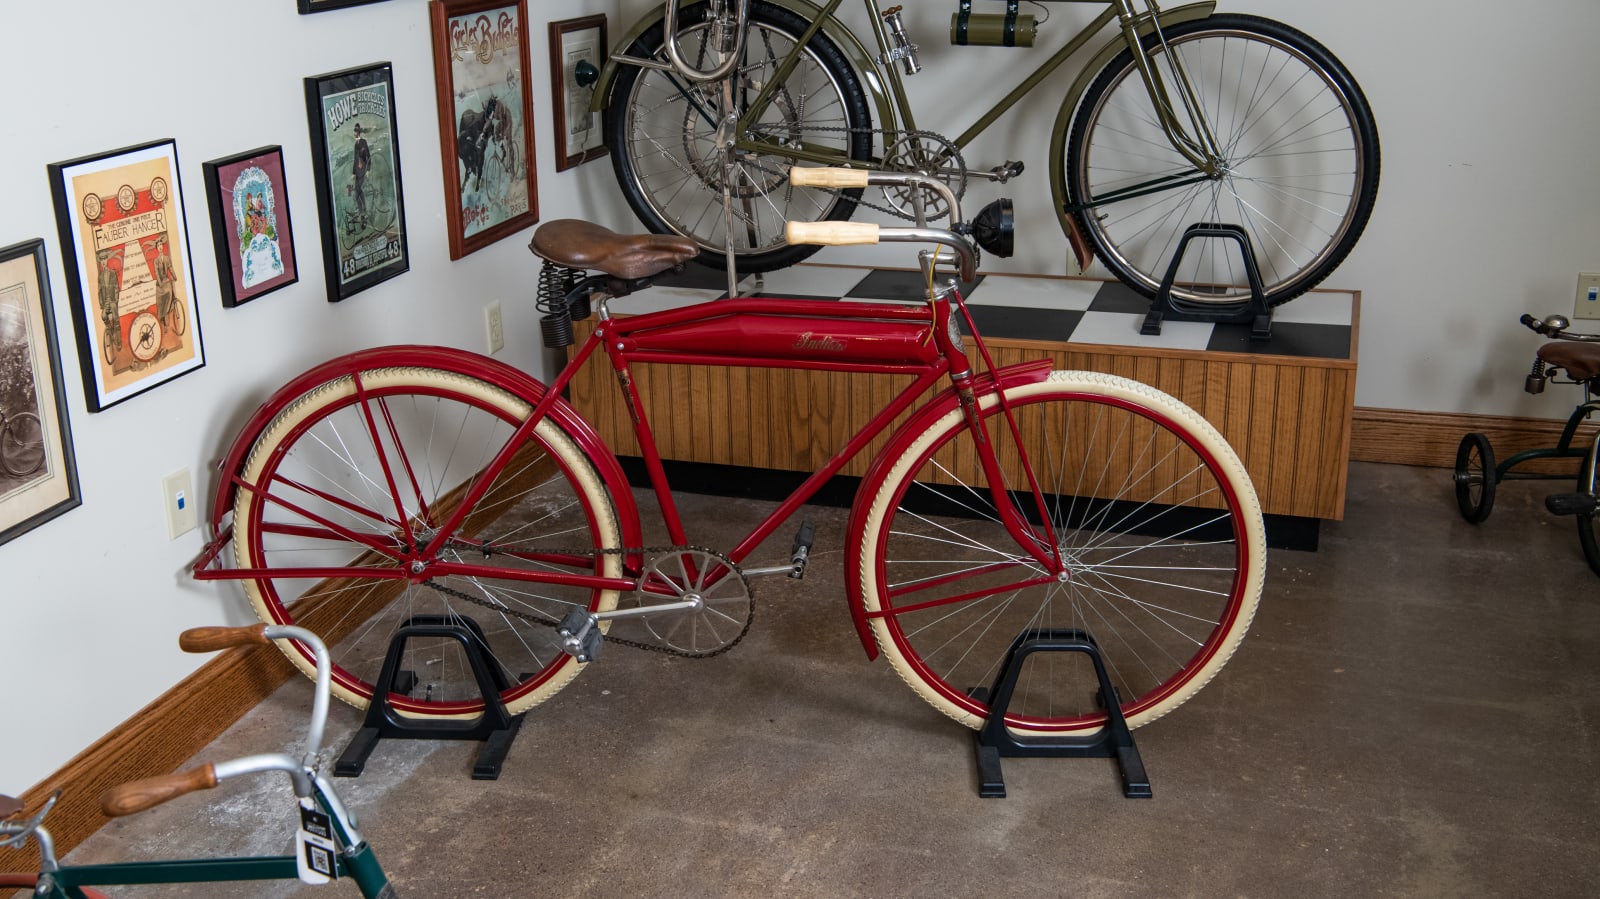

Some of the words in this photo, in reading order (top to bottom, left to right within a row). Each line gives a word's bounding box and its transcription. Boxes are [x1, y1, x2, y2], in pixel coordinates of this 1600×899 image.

[358, 91, 385, 106] BICYCLES
[328, 94, 358, 132] HOWE
[358, 103, 386, 118] TRICYCLES
[95, 228, 129, 249] FAUBER
[387, 241, 399, 258] 48
[343, 258, 356, 277] 48
[794, 331, 844, 351] Indian
